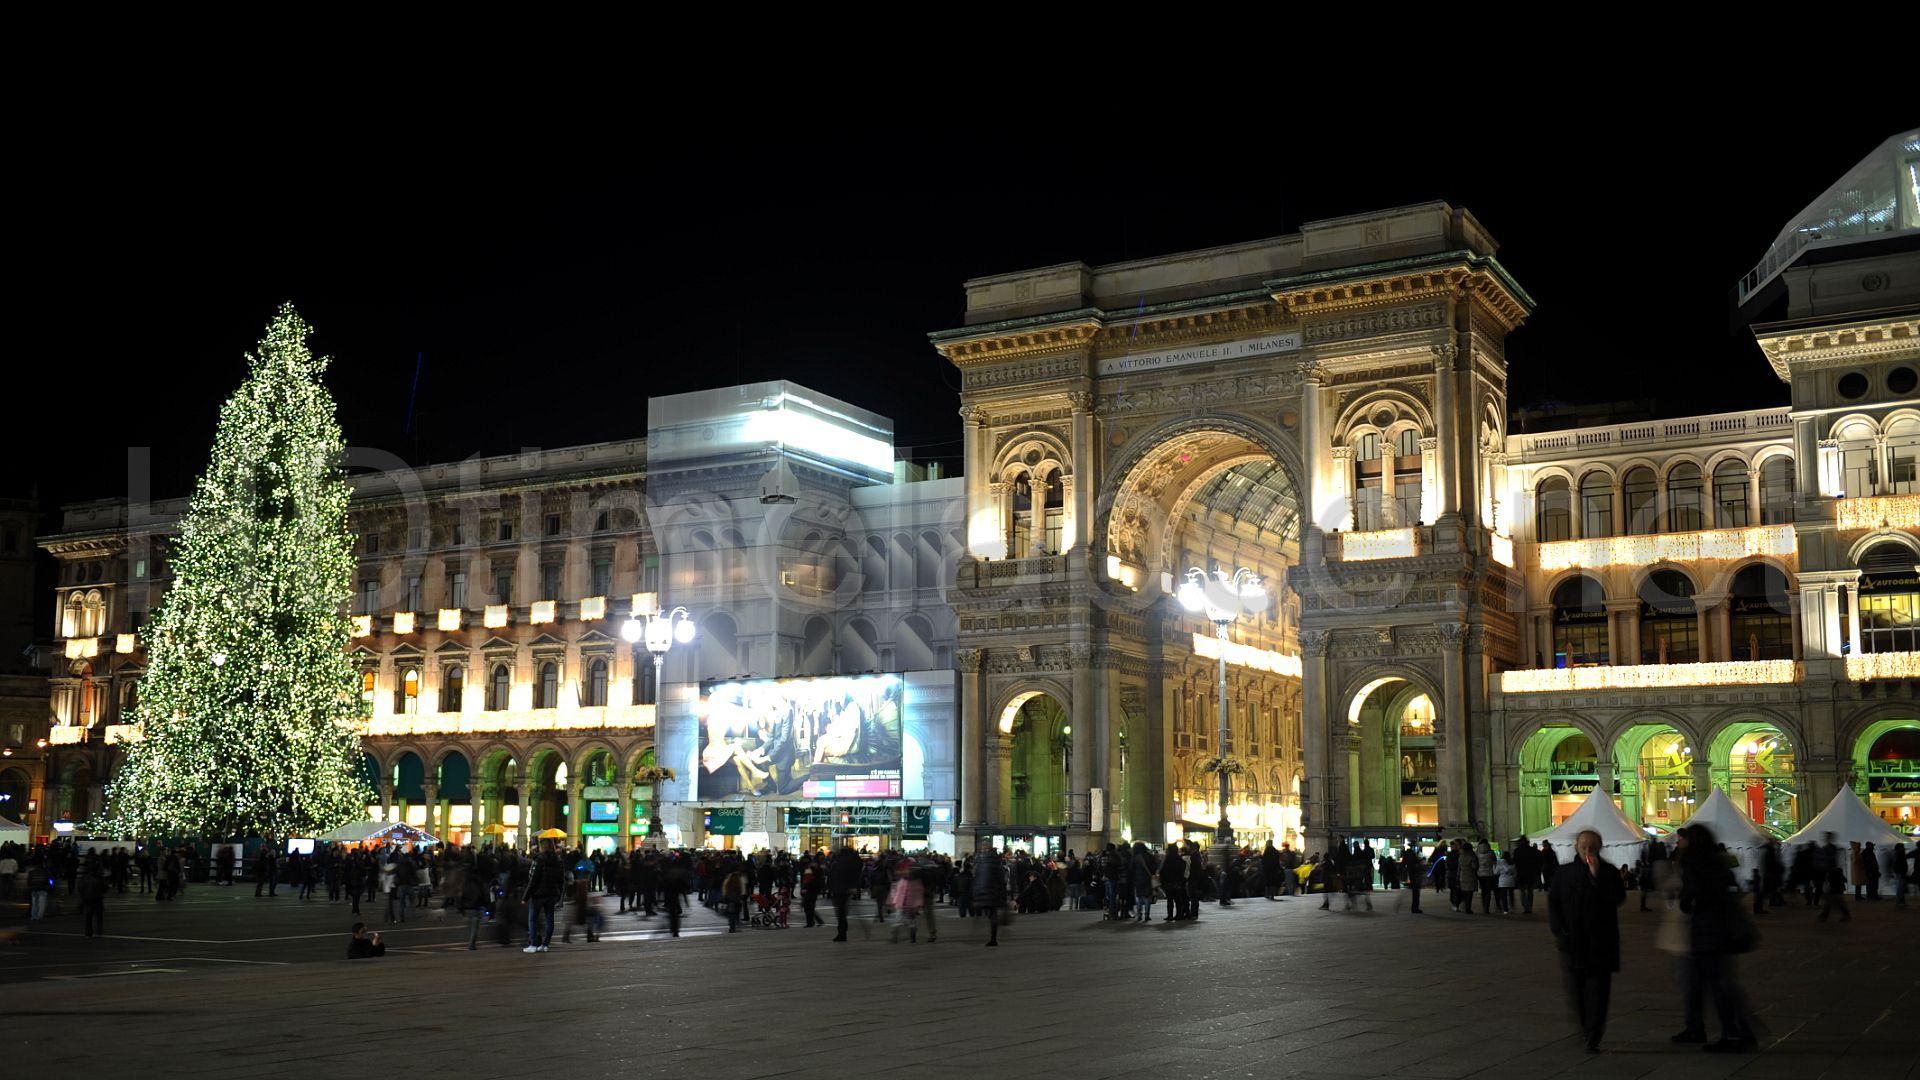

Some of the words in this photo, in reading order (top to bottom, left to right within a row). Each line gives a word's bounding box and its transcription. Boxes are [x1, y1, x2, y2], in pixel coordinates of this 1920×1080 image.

[1118, 356, 1161, 369] VITTORIO
[1166, 349, 1218, 363] EMANUELE
[1248, 338, 1294, 351] MILANESI
